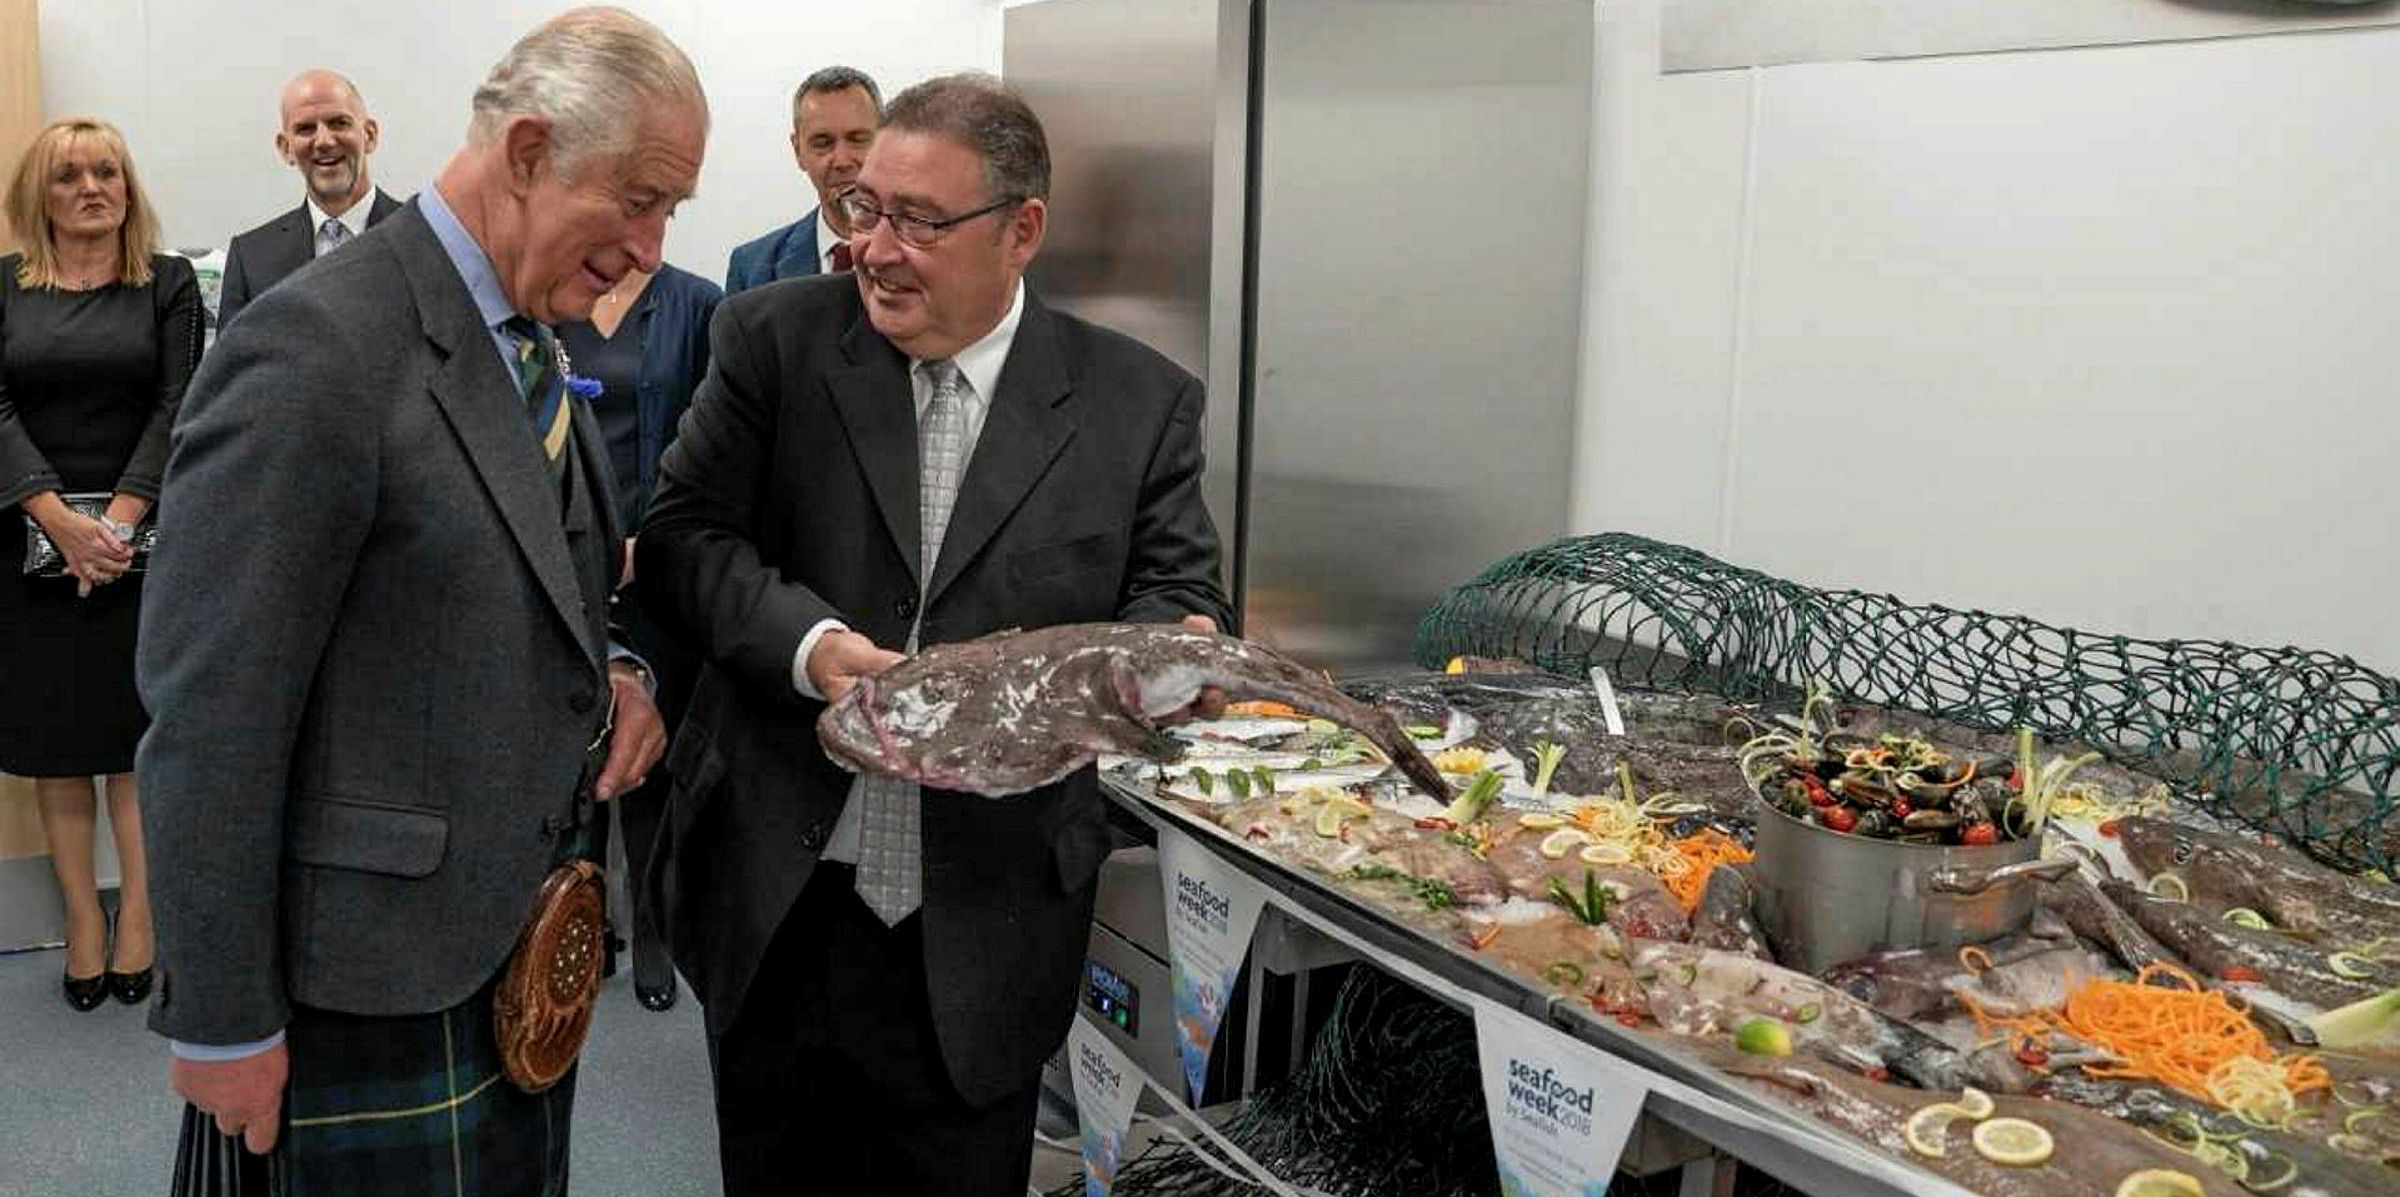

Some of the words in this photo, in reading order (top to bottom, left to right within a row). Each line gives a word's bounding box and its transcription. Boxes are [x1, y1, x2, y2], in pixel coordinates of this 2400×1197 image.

[1178, 871, 1229, 918] seafood
[1508, 1080, 1559, 1120] week
[1559, 1108, 1592, 1136] 2018
[1509, 1058, 1594, 1115] seafood
